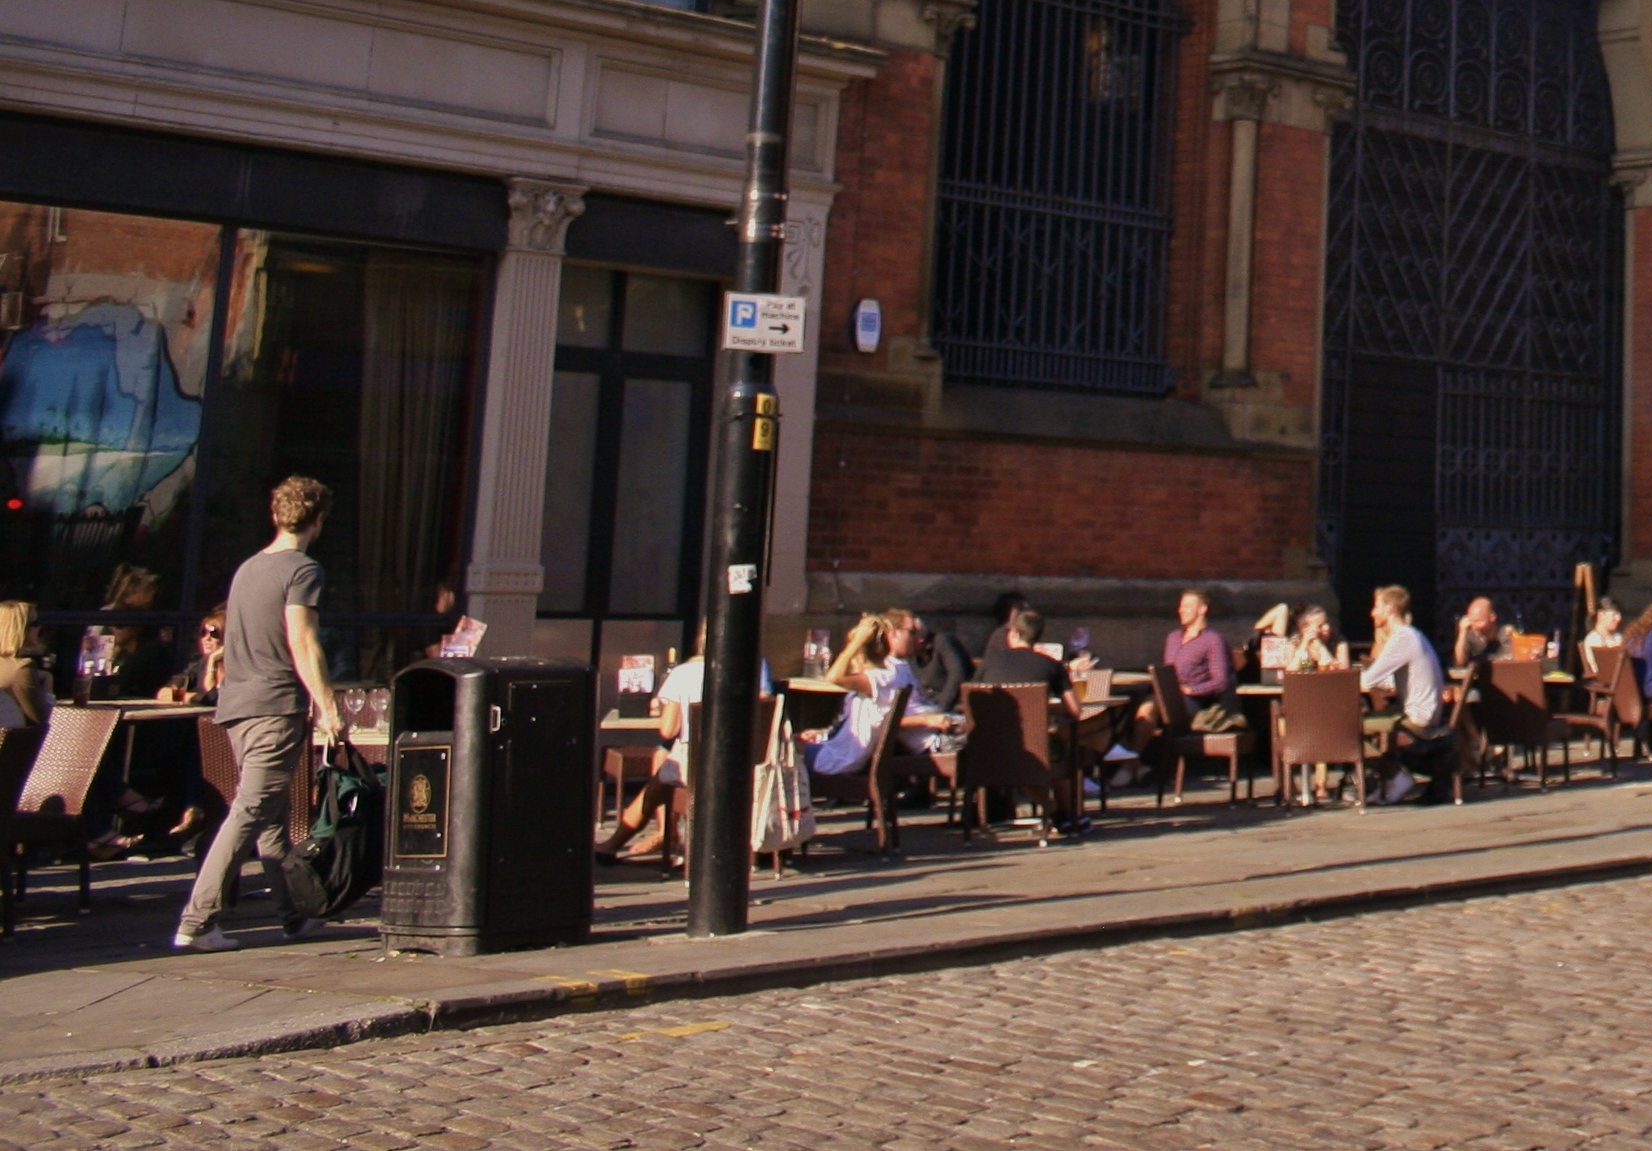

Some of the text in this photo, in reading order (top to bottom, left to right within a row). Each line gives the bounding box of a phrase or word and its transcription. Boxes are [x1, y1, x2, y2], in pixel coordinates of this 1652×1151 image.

[736, 304, 754, 326] P
[732, 336, 797, 347] Display ticket
